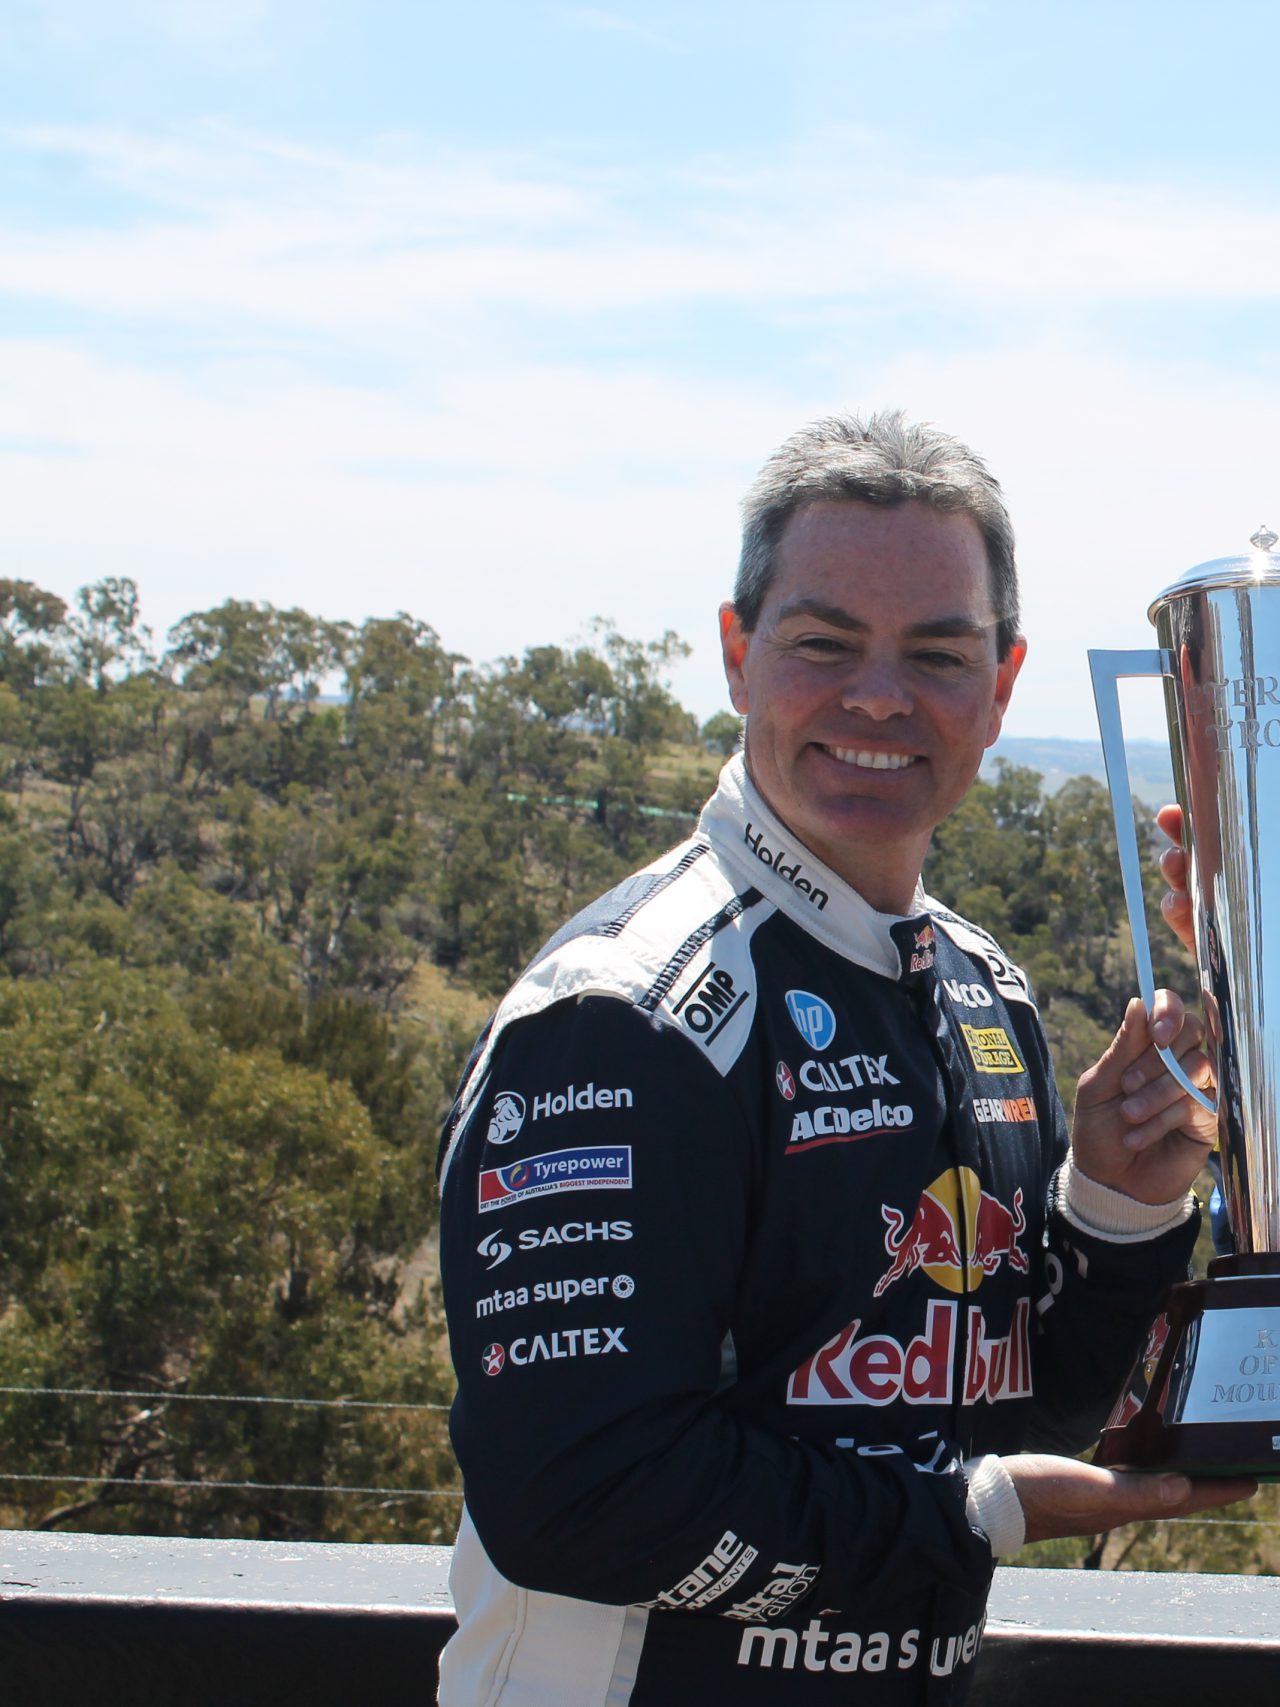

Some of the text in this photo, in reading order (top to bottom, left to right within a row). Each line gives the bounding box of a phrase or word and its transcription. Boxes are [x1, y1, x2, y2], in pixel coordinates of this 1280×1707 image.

[743, 822, 829, 912] Holden
[684, 968, 736, 1035] OMP
[799, 1054, 901, 1092] CALTEX
[532, 1082, 633, 1122] Holden
[789, 1098, 914, 1142] ACDelco
[534, 1156, 624, 1180] Tyrepower
[518, 1220, 634, 1251] SACHS
[476, 1275, 610, 1319] mtaa super
[509, 1326, 629, 1367] CALTEX
[786, 1298, 958, 1407] Red
[1239, 1354, 1279, 1376] OF
[704, 1547, 758, 1599] EVENTS
[736, 1618, 891, 1673] mtaa
